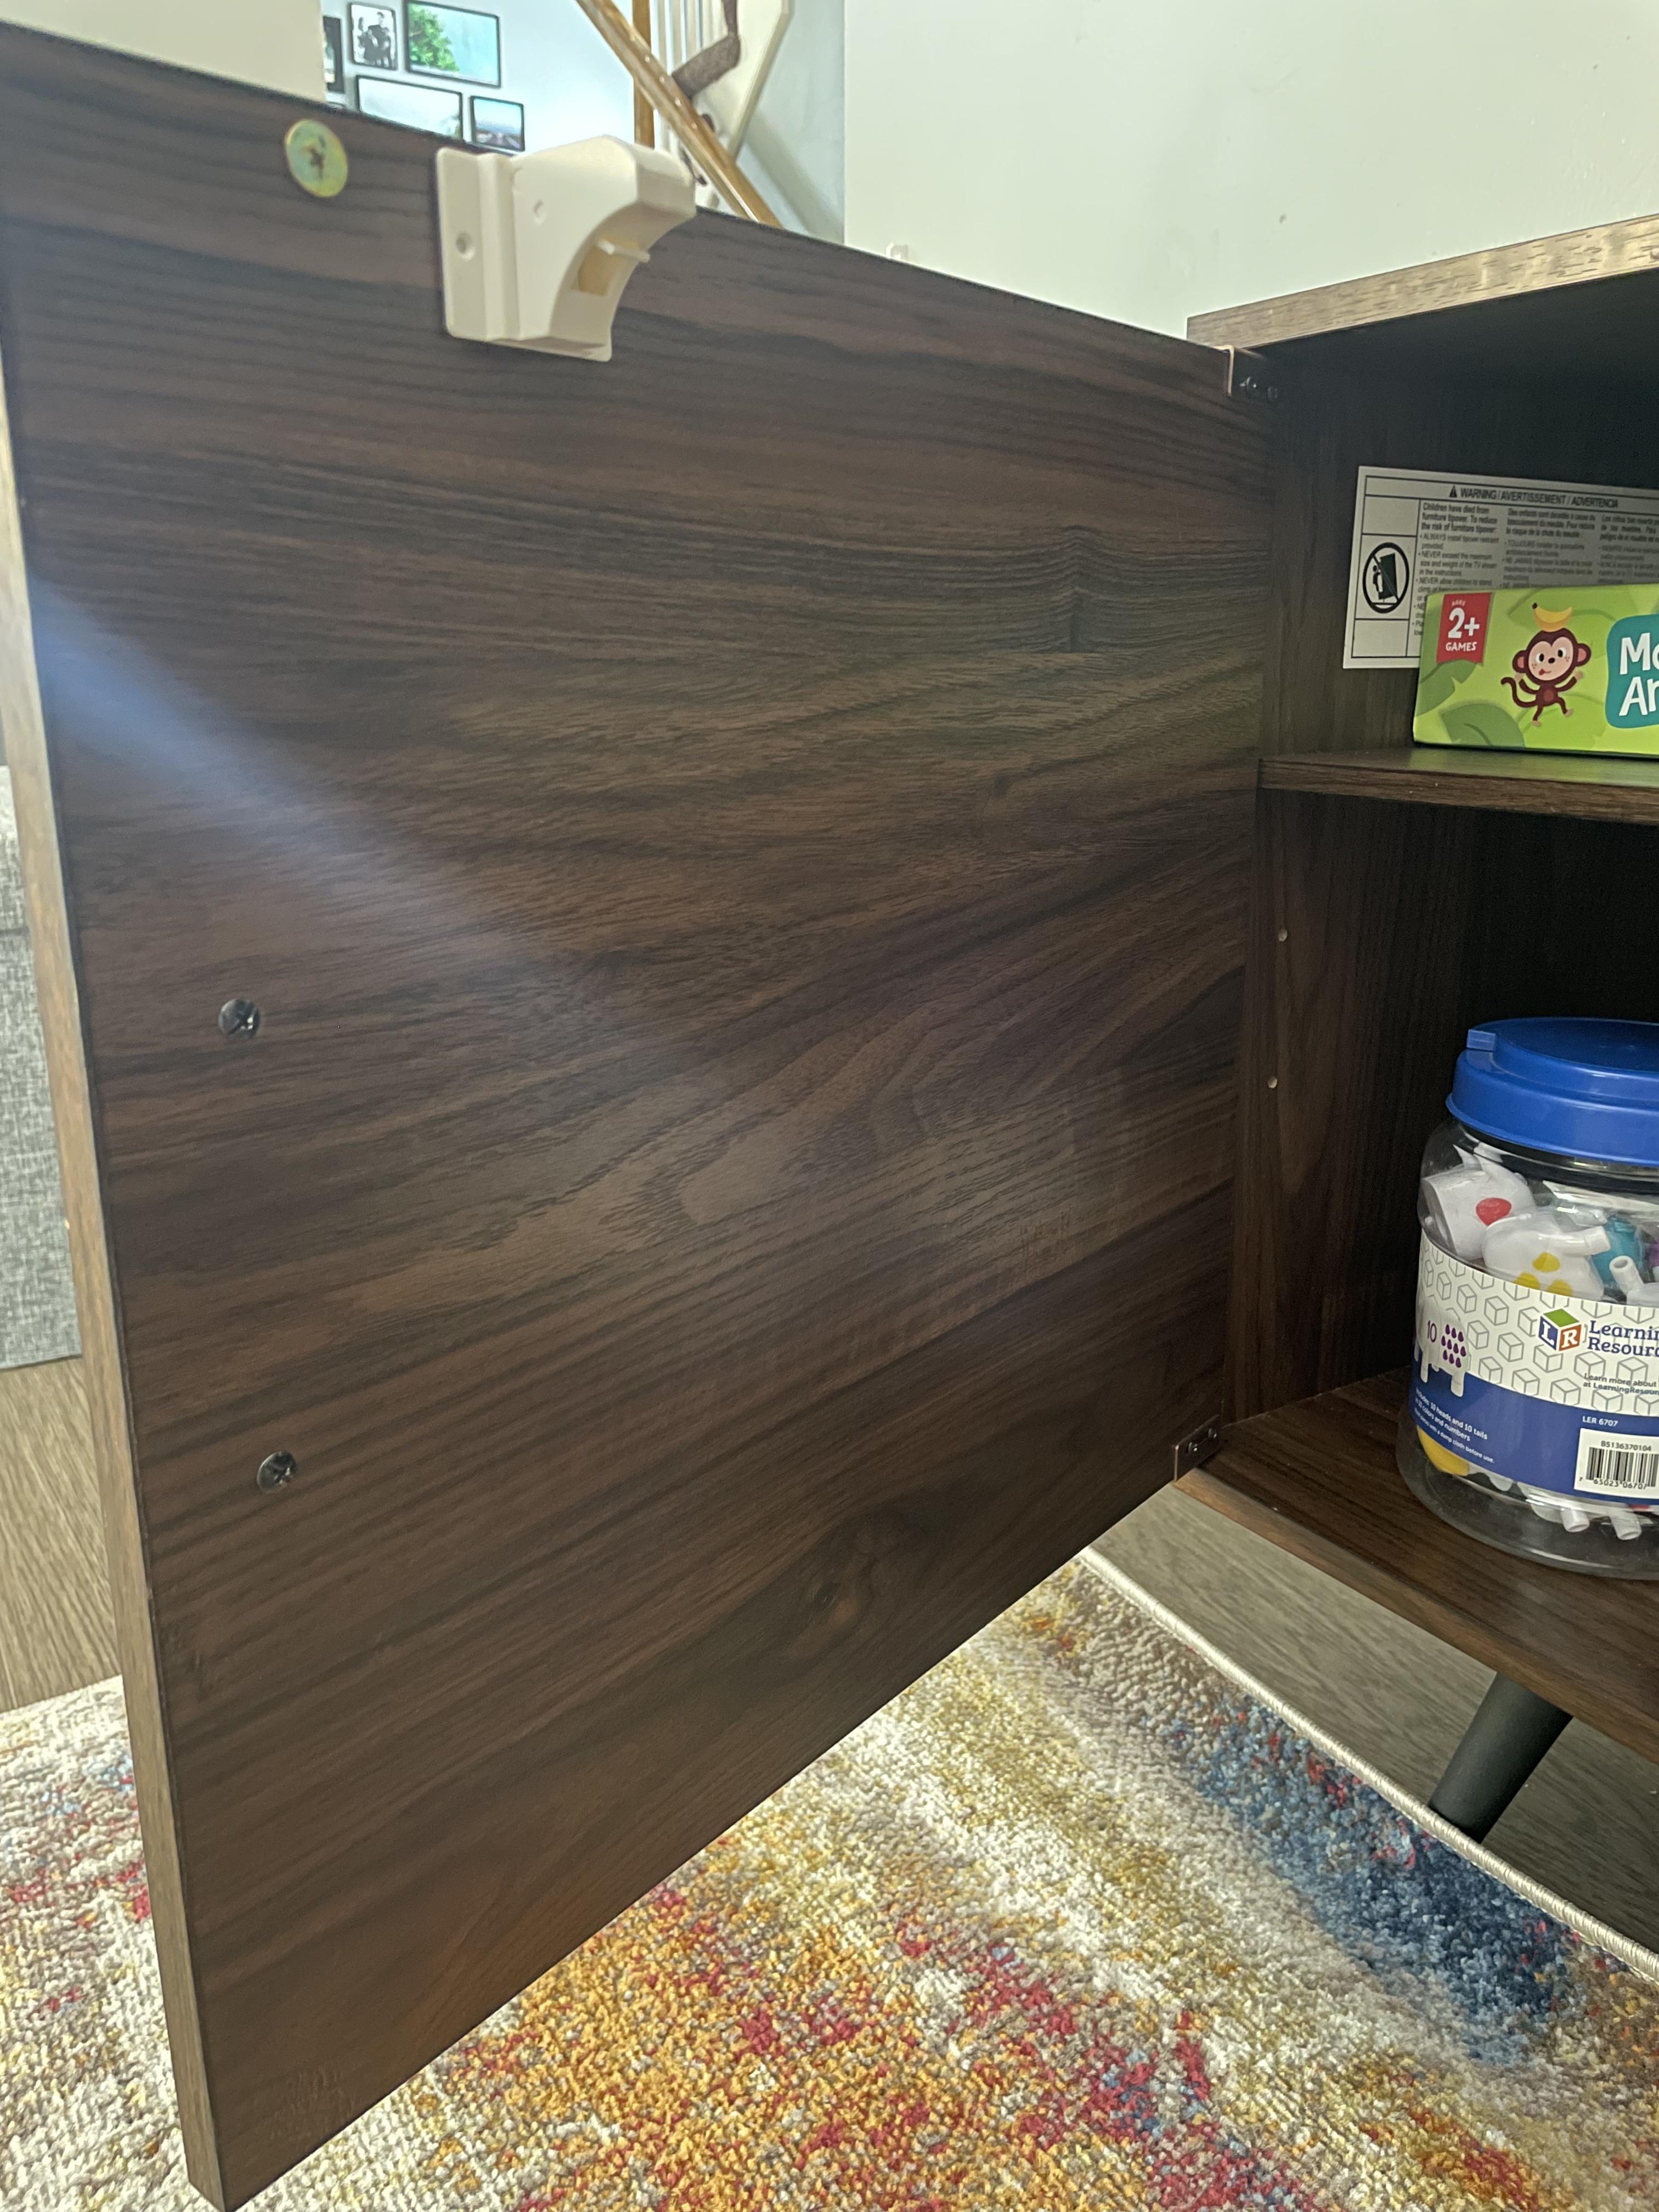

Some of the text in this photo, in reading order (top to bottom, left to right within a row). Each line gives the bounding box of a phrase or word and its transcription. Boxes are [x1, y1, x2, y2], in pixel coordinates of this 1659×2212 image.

[1460, 488, 1497, 500] WARNING
[1500, 491, 1566, 504] AVERTISSEMENT
[1571, 496, 1618, 508] ADVERTENCIA
[1423, 503, 1447, 511] Children
[1463, 505, 1476, 514] died
[1423, 512, 1446, 521] furniture
[1421, 522, 1430, 530] the
[1451, 523, 1474, 532] furniture
[1423, 533, 1447, 541] ALWAYS
[1421, 550, 1441, 558] NEVER
[1448, 607, 1480, 639] 2+
[1445, 641, 1477, 652] GAMES
[1427, 1320, 1437, 1343] 10
[1584, 1373, 1607, 1382] Learn
[1430, 1402, 1436, 1410] 10
[1436, 1407, 1451, 1421] heads
[1452, 1418, 1463, 1428] and
[1464, 1423, 1472, 1432] 10
[1474, 1428, 1487, 1440] tails
[1582, 1415, 1618, 1426] LER 6707
[1435, 1417, 1444, 1426] and
[1444, 1424, 1470, 1442] numbers
[1440, 1432, 1452, 1443] damp
[1452, 1440, 1465, 1450] cloth
[1465, 1446, 1482, 1459] before
[1483, 1455, 1495, 1464] use.
[1593, 1479, 1619, 1488] 65023
[1622, 1482, 1648, 1490] 06707
